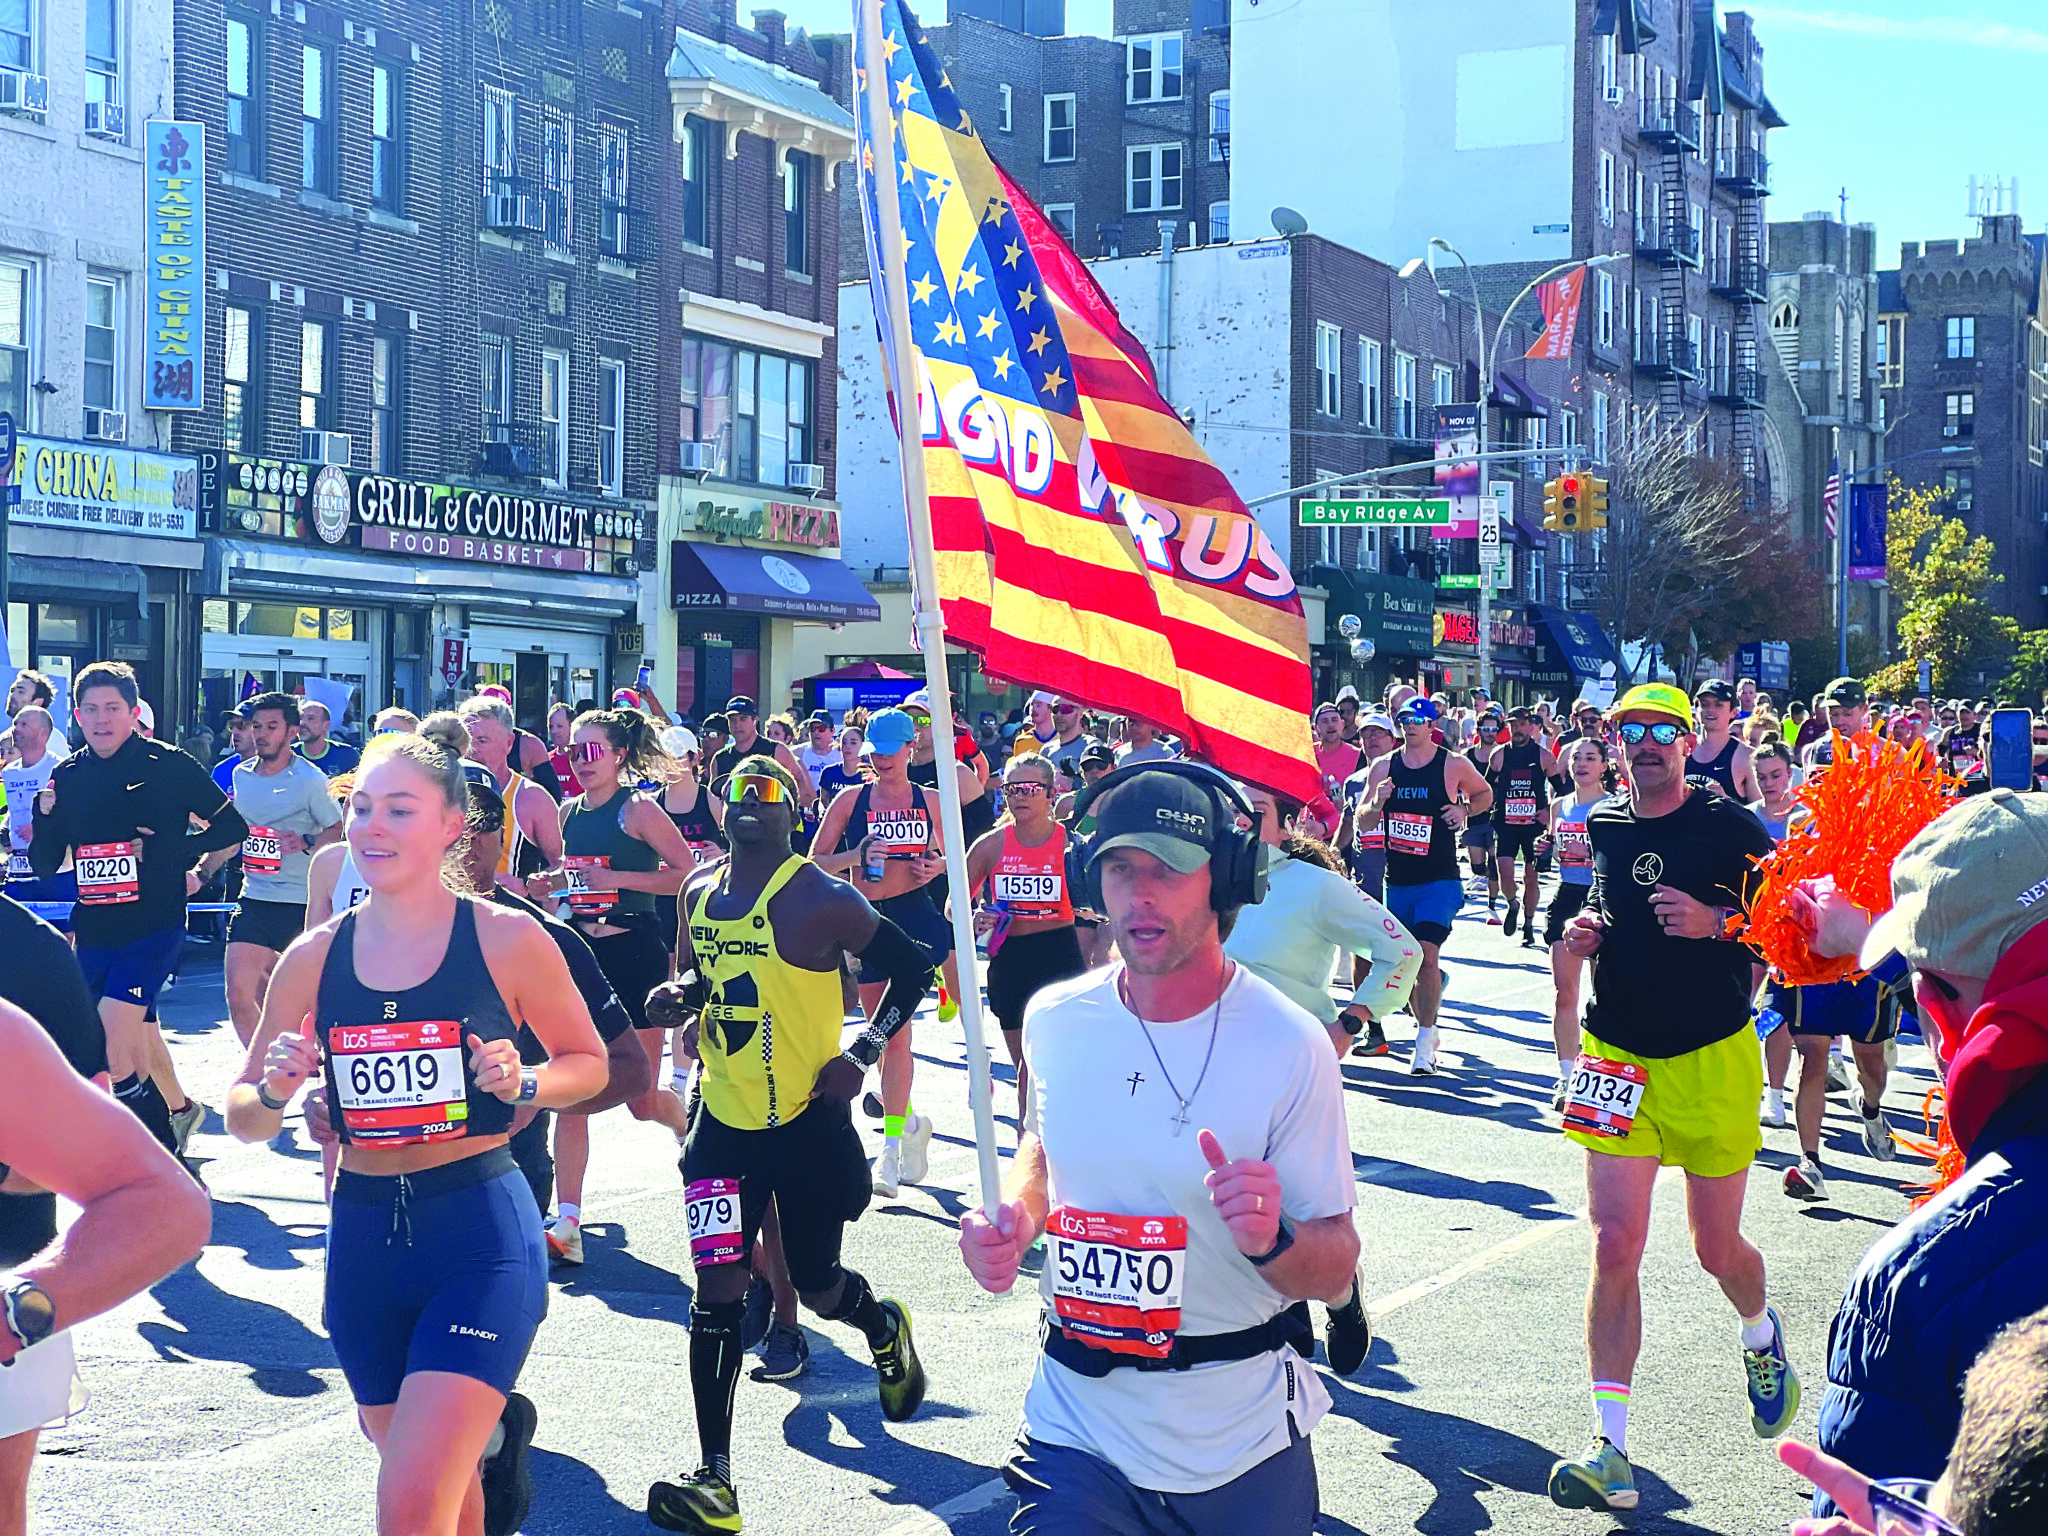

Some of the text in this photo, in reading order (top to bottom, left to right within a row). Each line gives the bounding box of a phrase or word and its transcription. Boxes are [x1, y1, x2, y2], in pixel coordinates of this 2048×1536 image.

[155, 177, 193, 355] TASTE OF CHINA
[1545, 277, 1571, 357] MARAON
[1449, 417, 1465, 426] NOV
[36, 446, 120, 502] CHINA
[201, 453, 218, 529] DELI
[47, 500, 80, 521] CUISINE
[82, 506, 103, 521] FREE
[106, 508, 145, 527] DELIVERY
[357, 475, 588, 548] GRILL & GOURMET
[1315, 505, 1436, 523] Bay Ridge Av
[769, 500, 840, 549] PIZZA
[1481, 525, 1497, 543] 25
[389, 530, 544, 566] FOOD BASKET
[676, 593, 722, 605] PIZZA
[1444, 612, 1480, 645] BAGEL
[448, 641, 458, 672] ATM
[1572, 655, 1603, 673] CLEAN
[1531, 672, 1568, 682] TAILORS
[25, 779, 38, 787] TCS
[1397, 787, 1428, 799] KEVIN
[1506, 790, 1537, 799] ULTRA
[875, 809, 923, 824] JULIANA
[1507, 803, 1535, 814] 26907
[872, 822, 924, 840] 20010
[1390, 819, 1428, 838] 15855
[80, 857, 131, 879] 18220
[1002, 875, 1055, 896] 15519
[691, 925, 720, 942] NEW
[715, 940, 769, 958] YORK
[343, 1031, 368, 1049] tcs
[419, 1036, 442, 1045] TATA
[351, 1053, 439, 1096] 6619
[363, 1097, 388, 1105] ORANGE
[388, 1095, 415, 1104] CORRAL
[415, 1093, 424, 1103] C
[422, 1121, 454, 1135] 2024
[1598, 1122, 1619, 1135] 2024
[1060, 1210, 1086, 1235] tcs
[1139, 1236, 1167, 1245] TATA
[713, 1246, 734, 1256] 2024
[1058, 1240, 1174, 1296] 54750
[1057, 1285, 1139, 1303] WAVE 5 ORANGE CORRAL
[459, 1326, 499, 1342] BANDIT
[1070, 1322, 1124, 1337] #TCSNYCMarathon
